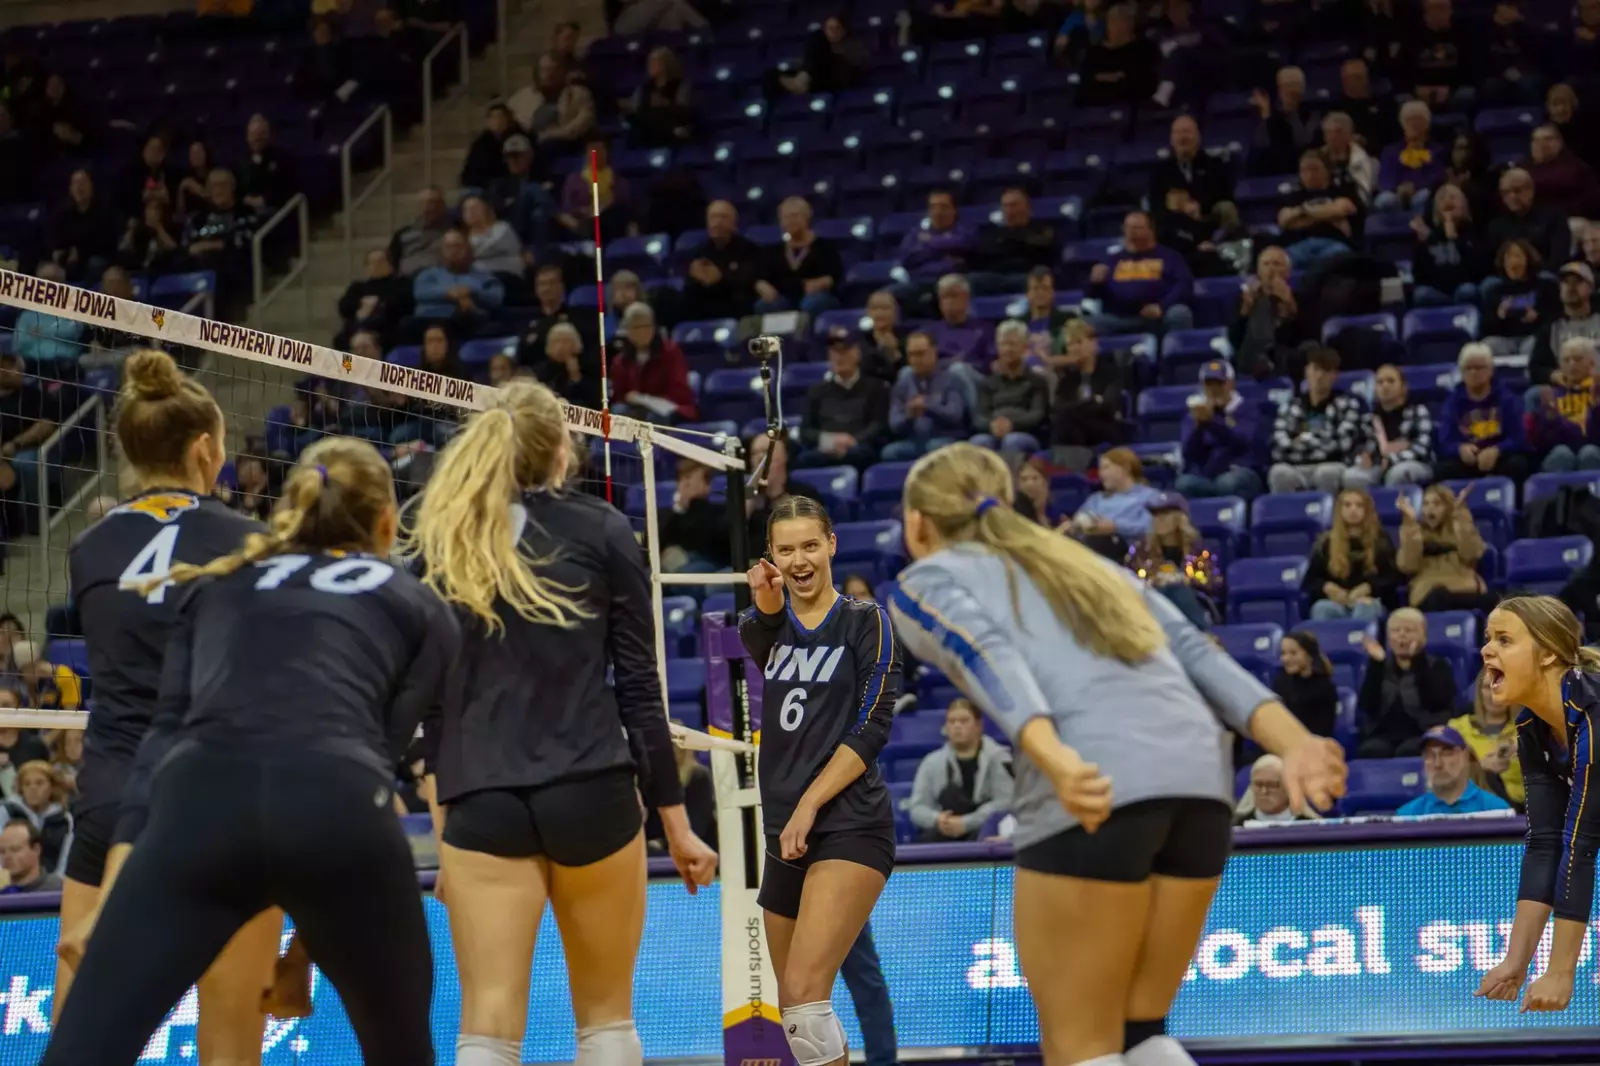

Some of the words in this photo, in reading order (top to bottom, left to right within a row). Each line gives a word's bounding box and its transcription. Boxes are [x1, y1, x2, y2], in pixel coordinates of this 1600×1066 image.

[0, 271, 70, 309] RTHERN
[73, 288, 116, 320] IOWA
[200, 319, 275, 356] NORTHERN
[278, 338, 312, 366] IOWA
[380, 363, 442, 395] NORTHERN
[445, 377, 474, 402] IOWA
[118, 525, 180, 604] 4
[764, 644, 845, 681] UNI
[779, 688, 807, 732] 6
[745, 917, 763, 971] sports
